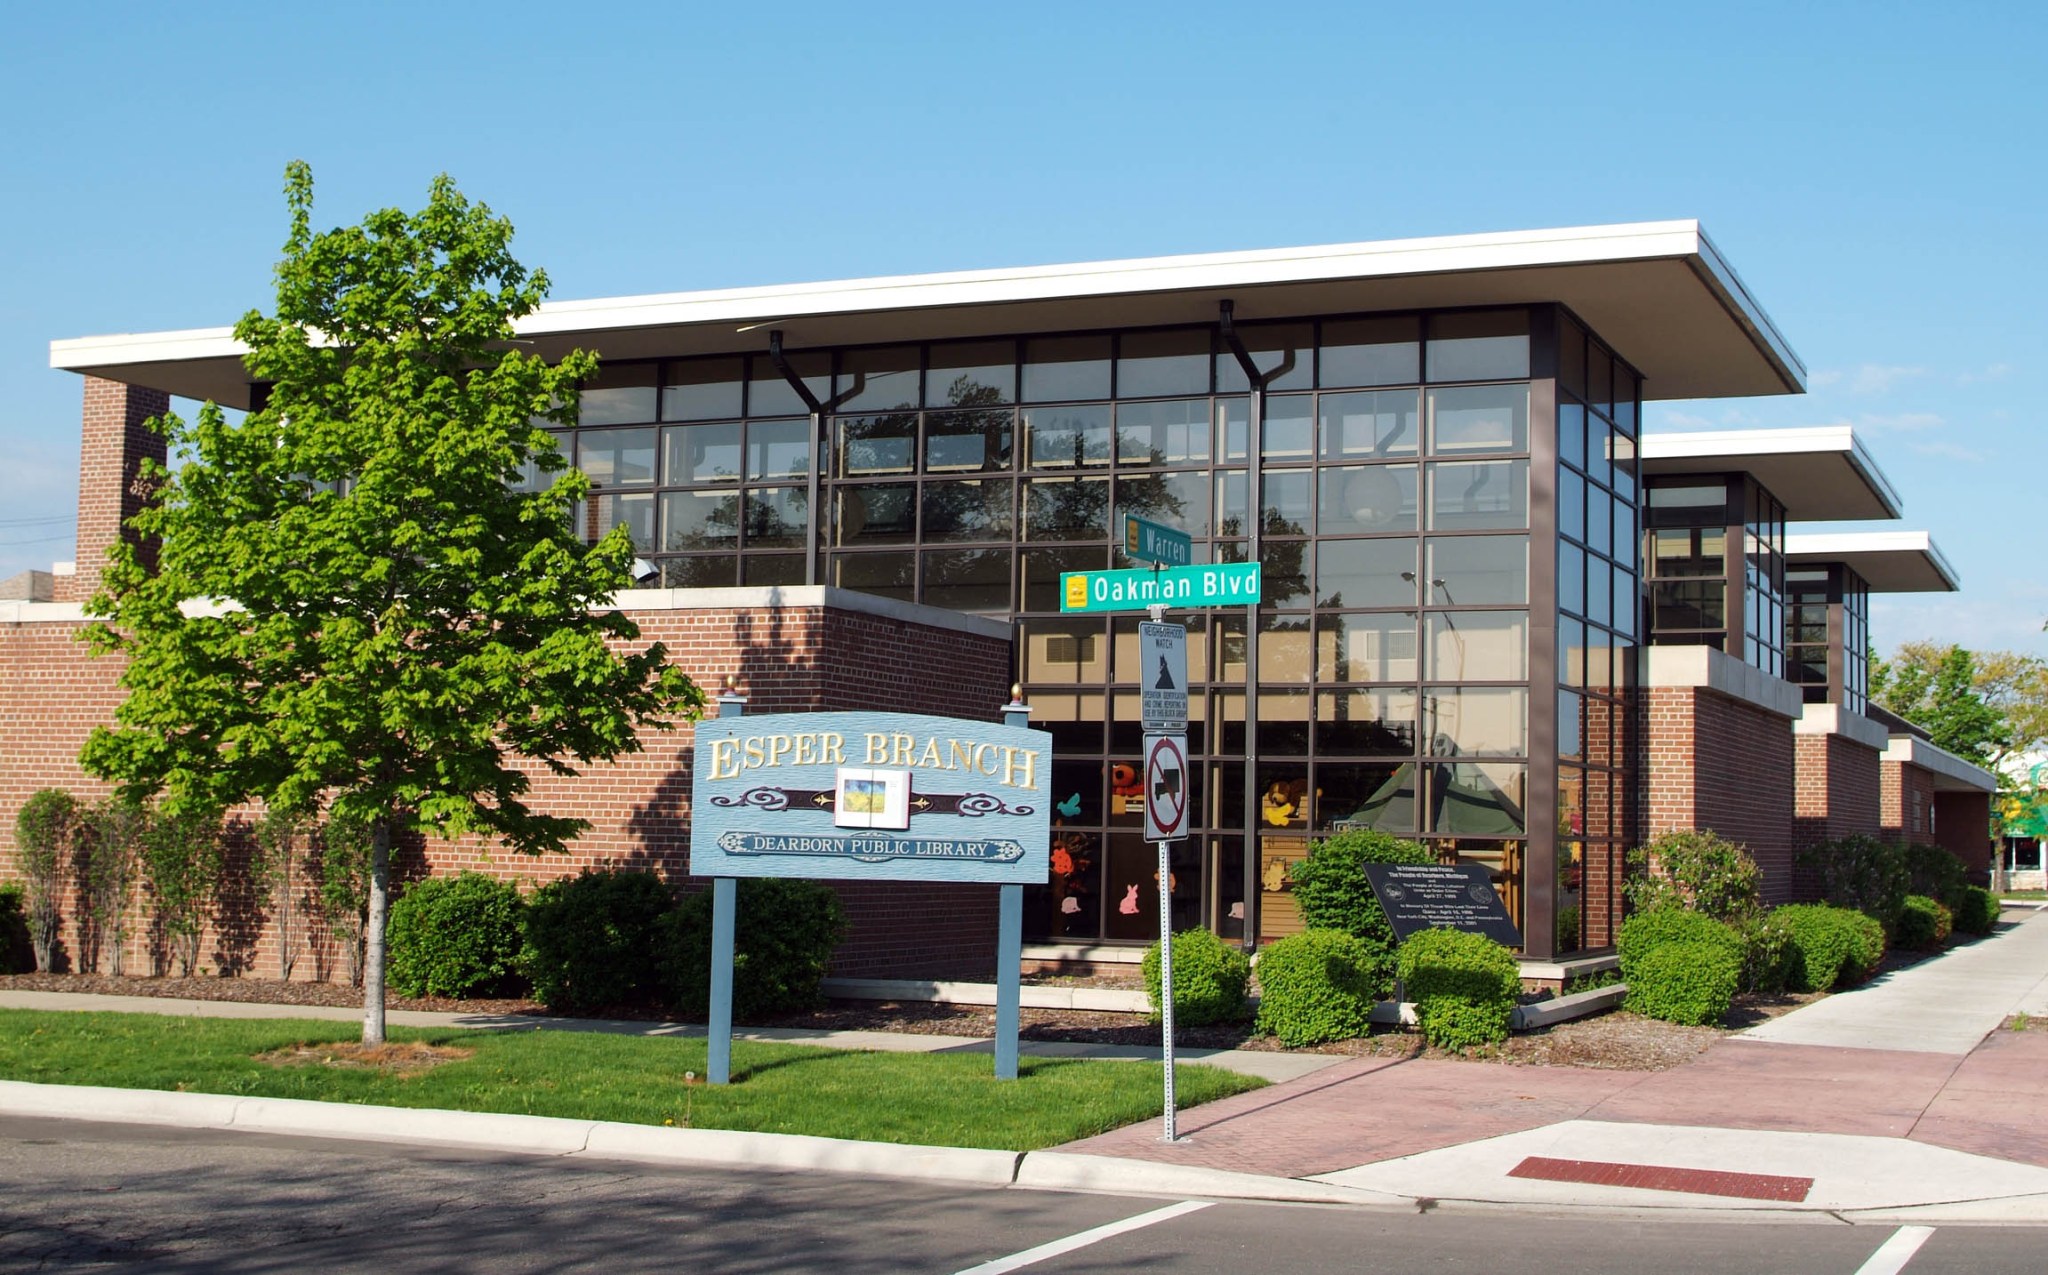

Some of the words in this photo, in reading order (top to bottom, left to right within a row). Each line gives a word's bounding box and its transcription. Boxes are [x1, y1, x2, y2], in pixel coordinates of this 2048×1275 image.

[1146, 528, 1186, 563] Warren
[1094, 576, 1191, 602] Oakman
[1203, 568, 1258, 597] Blvd
[1143, 625, 1184, 640] NEIGHBORHOOD
[1155, 638, 1173, 650] WATCH
[706, 731, 848, 782] ESPER
[862, 731, 1040, 791] BRANCH
[752, 836, 846, 853] DEARBORN
[851, 841, 911, 854] PUBLIC
[915, 842, 989, 857] LIBRARY
